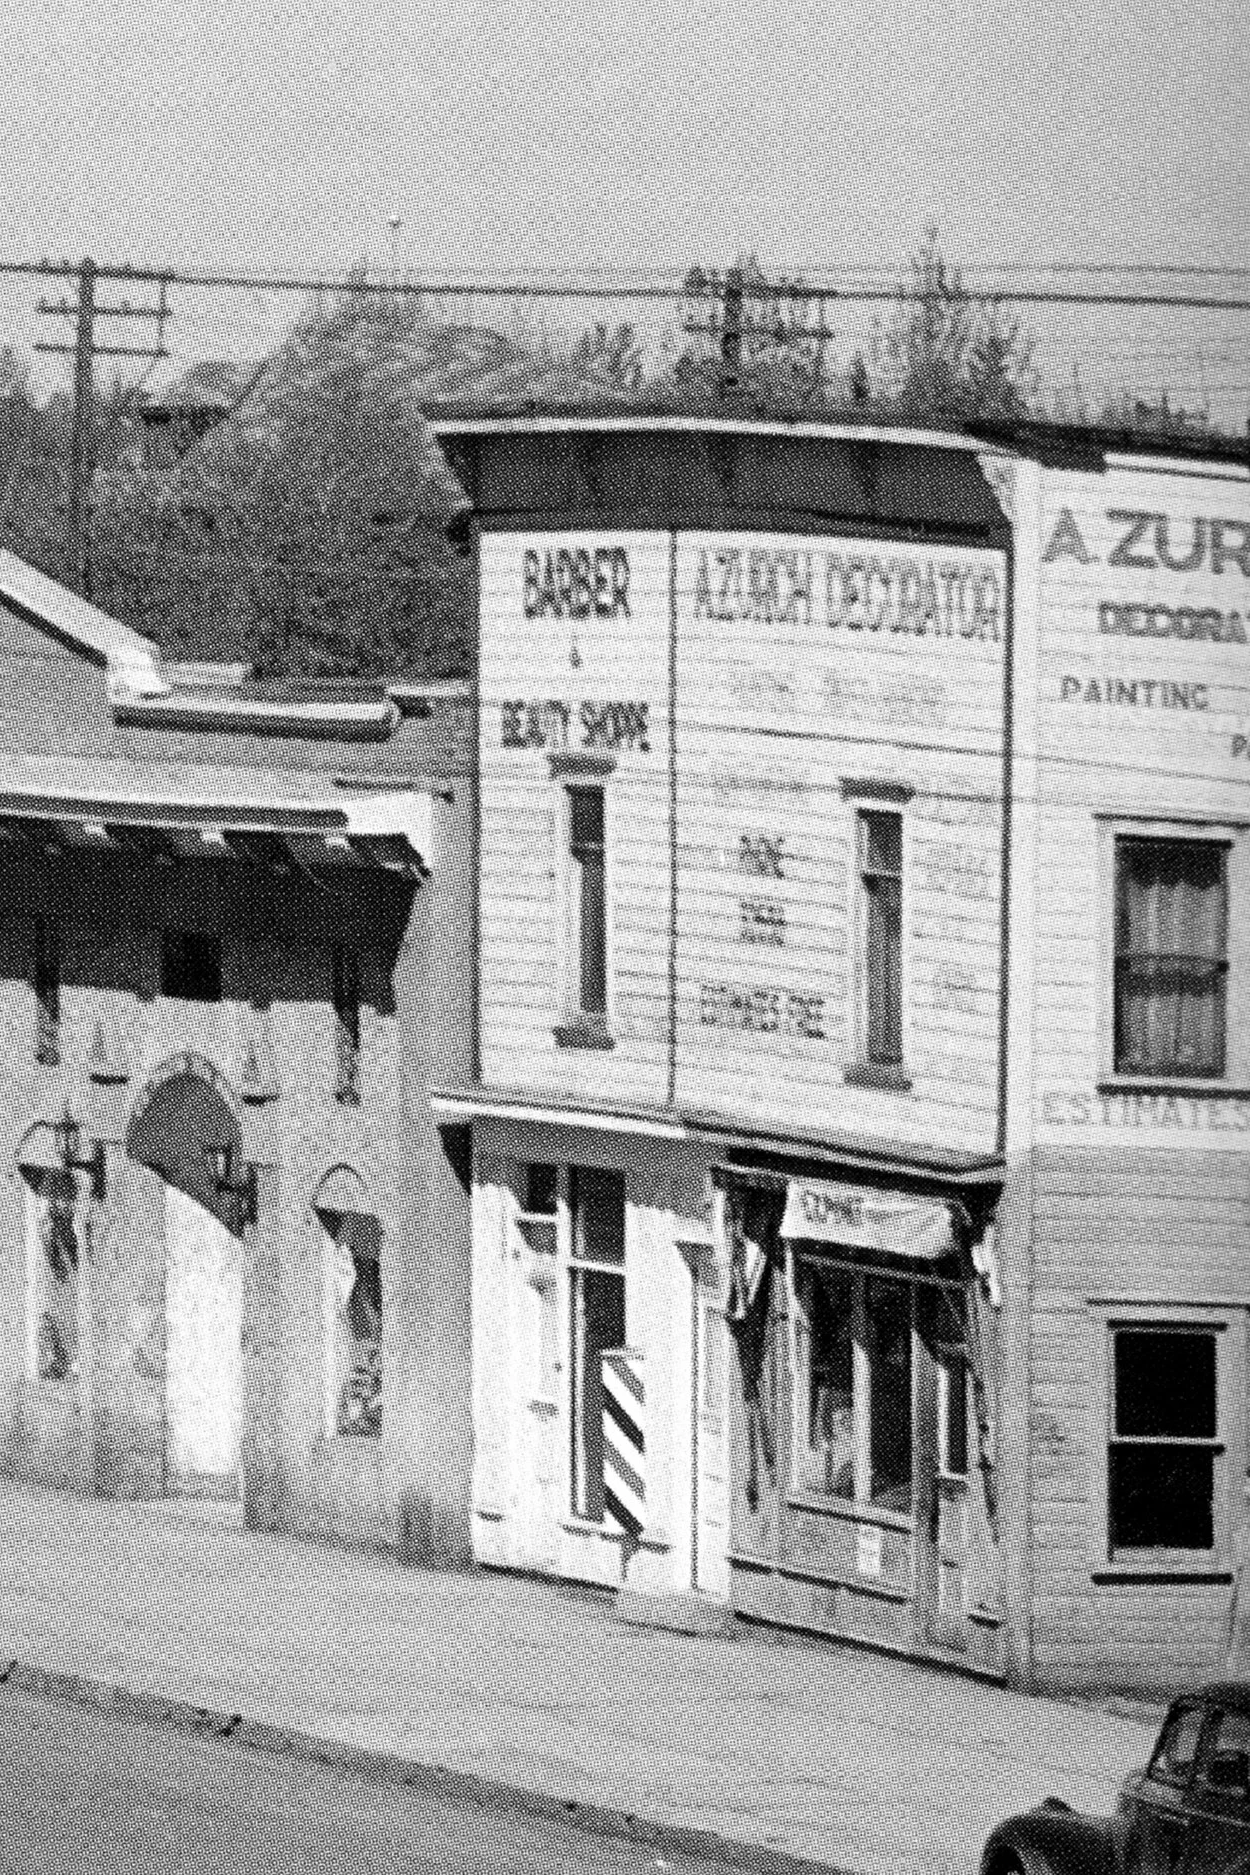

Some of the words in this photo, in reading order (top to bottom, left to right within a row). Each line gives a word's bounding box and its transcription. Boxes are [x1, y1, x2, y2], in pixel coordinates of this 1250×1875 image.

[524, 548, 632, 620] BARBER
[826, 552, 1000, 642] DECORATOR
[1099, 600, 1250, 644] DECORA
[1061, 674, 1209, 711] PAINTING
[502, 700, 571, 749] BEAUTY
[580, 700, 651, 753] SHOPPE
